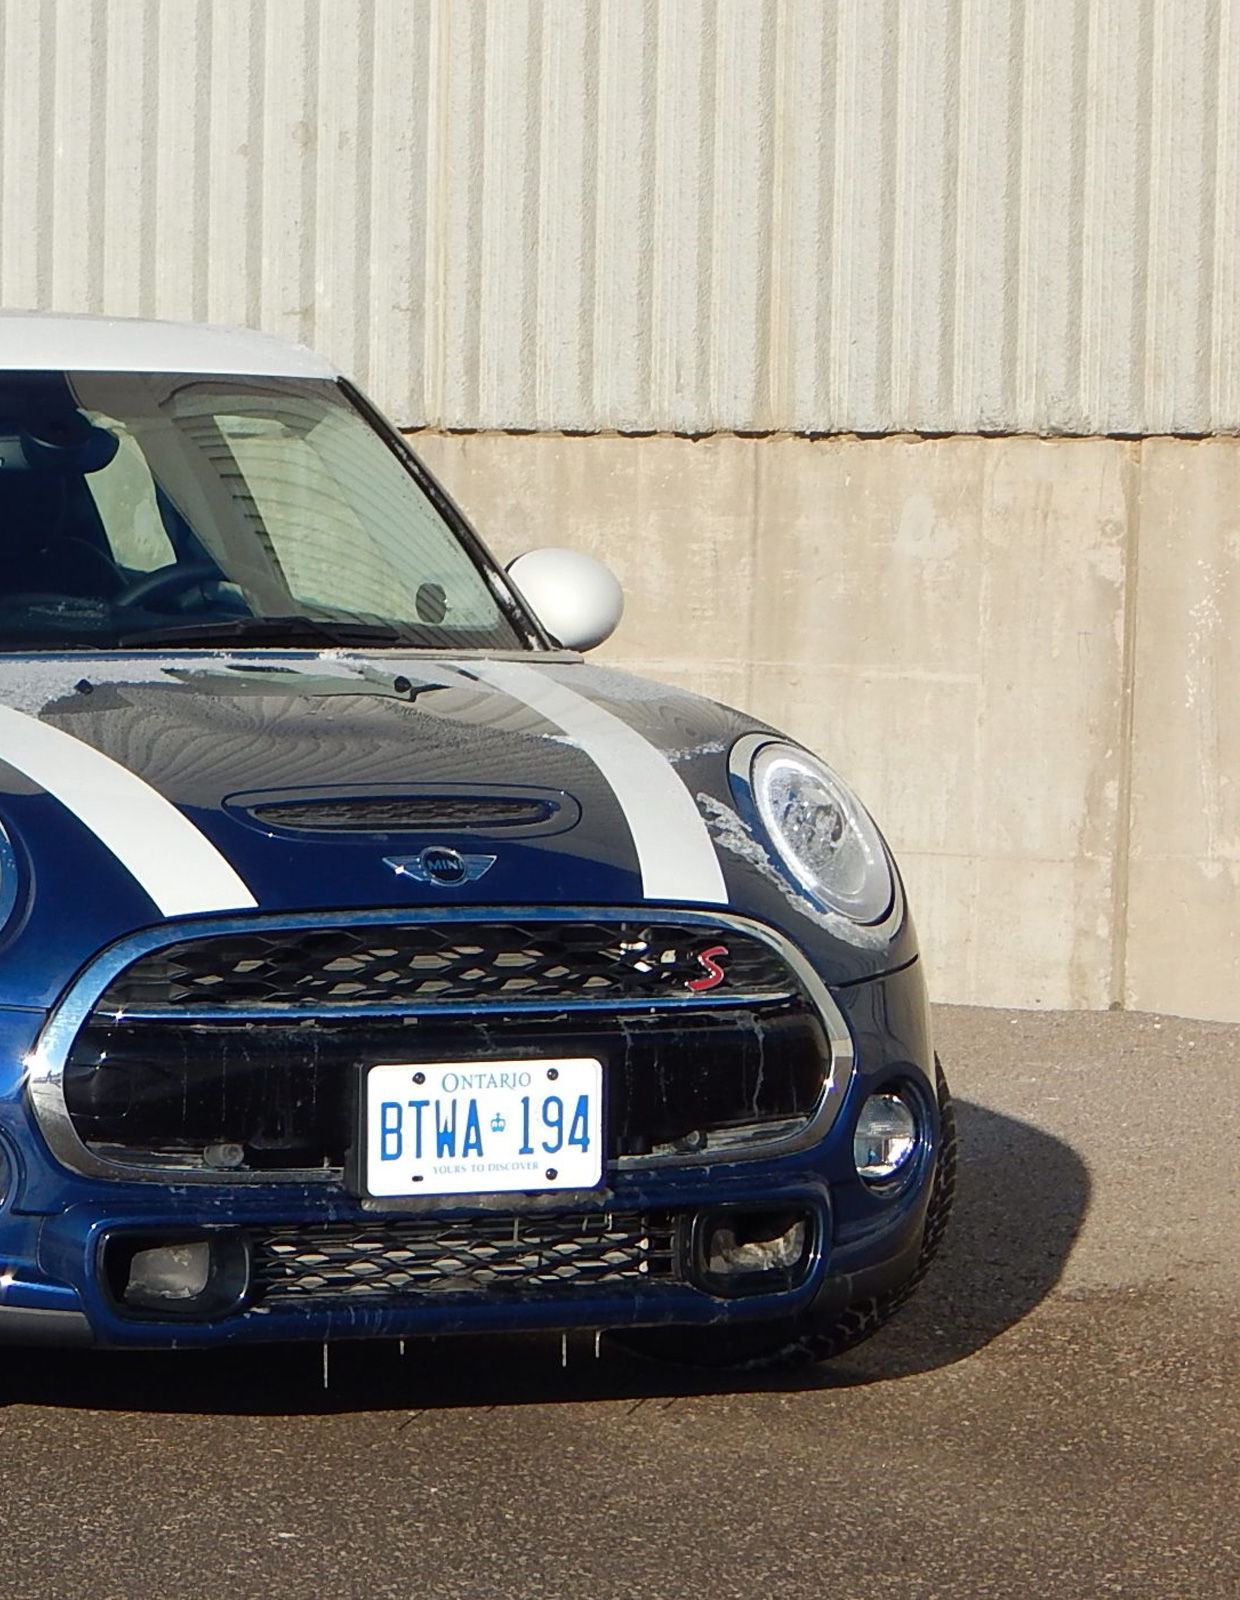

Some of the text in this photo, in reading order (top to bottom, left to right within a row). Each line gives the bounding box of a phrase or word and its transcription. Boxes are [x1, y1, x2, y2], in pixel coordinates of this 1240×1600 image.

[427, 859, 464, 870] MINI
[685, 946, 728, 991] S
[442, 1072, 532, 1093] ONTARIO
[380, 1095, 590, 1161] BTWA 194
[432, 1161, 539, 1175] YOURS TO DISCOVER
